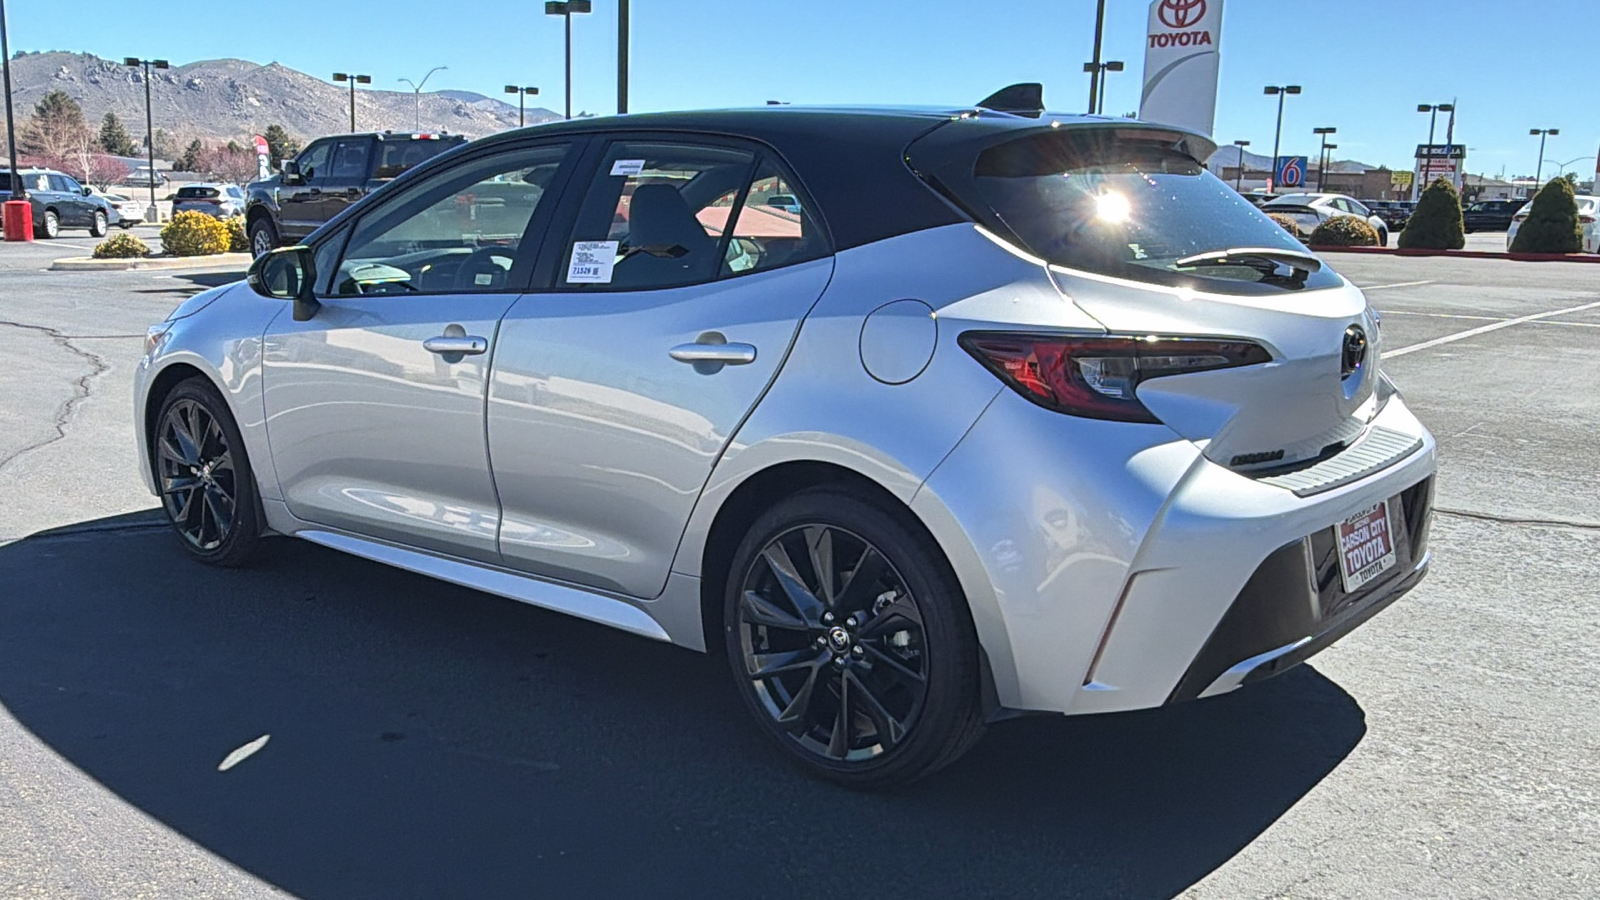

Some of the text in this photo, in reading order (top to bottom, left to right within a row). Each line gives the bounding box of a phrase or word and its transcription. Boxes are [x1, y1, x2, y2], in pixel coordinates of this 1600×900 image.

[1148, 30, 1212, 48] TOYOTA
[1282, 157, 1302, 188] 6
[1341, 525, 1371, 553] CARSON
[1370, 516, 1386, 537] CITY
[1347, 536, 1386, 573] TOYOTA
[1359, 560, 1384, 582] TOYOTA
